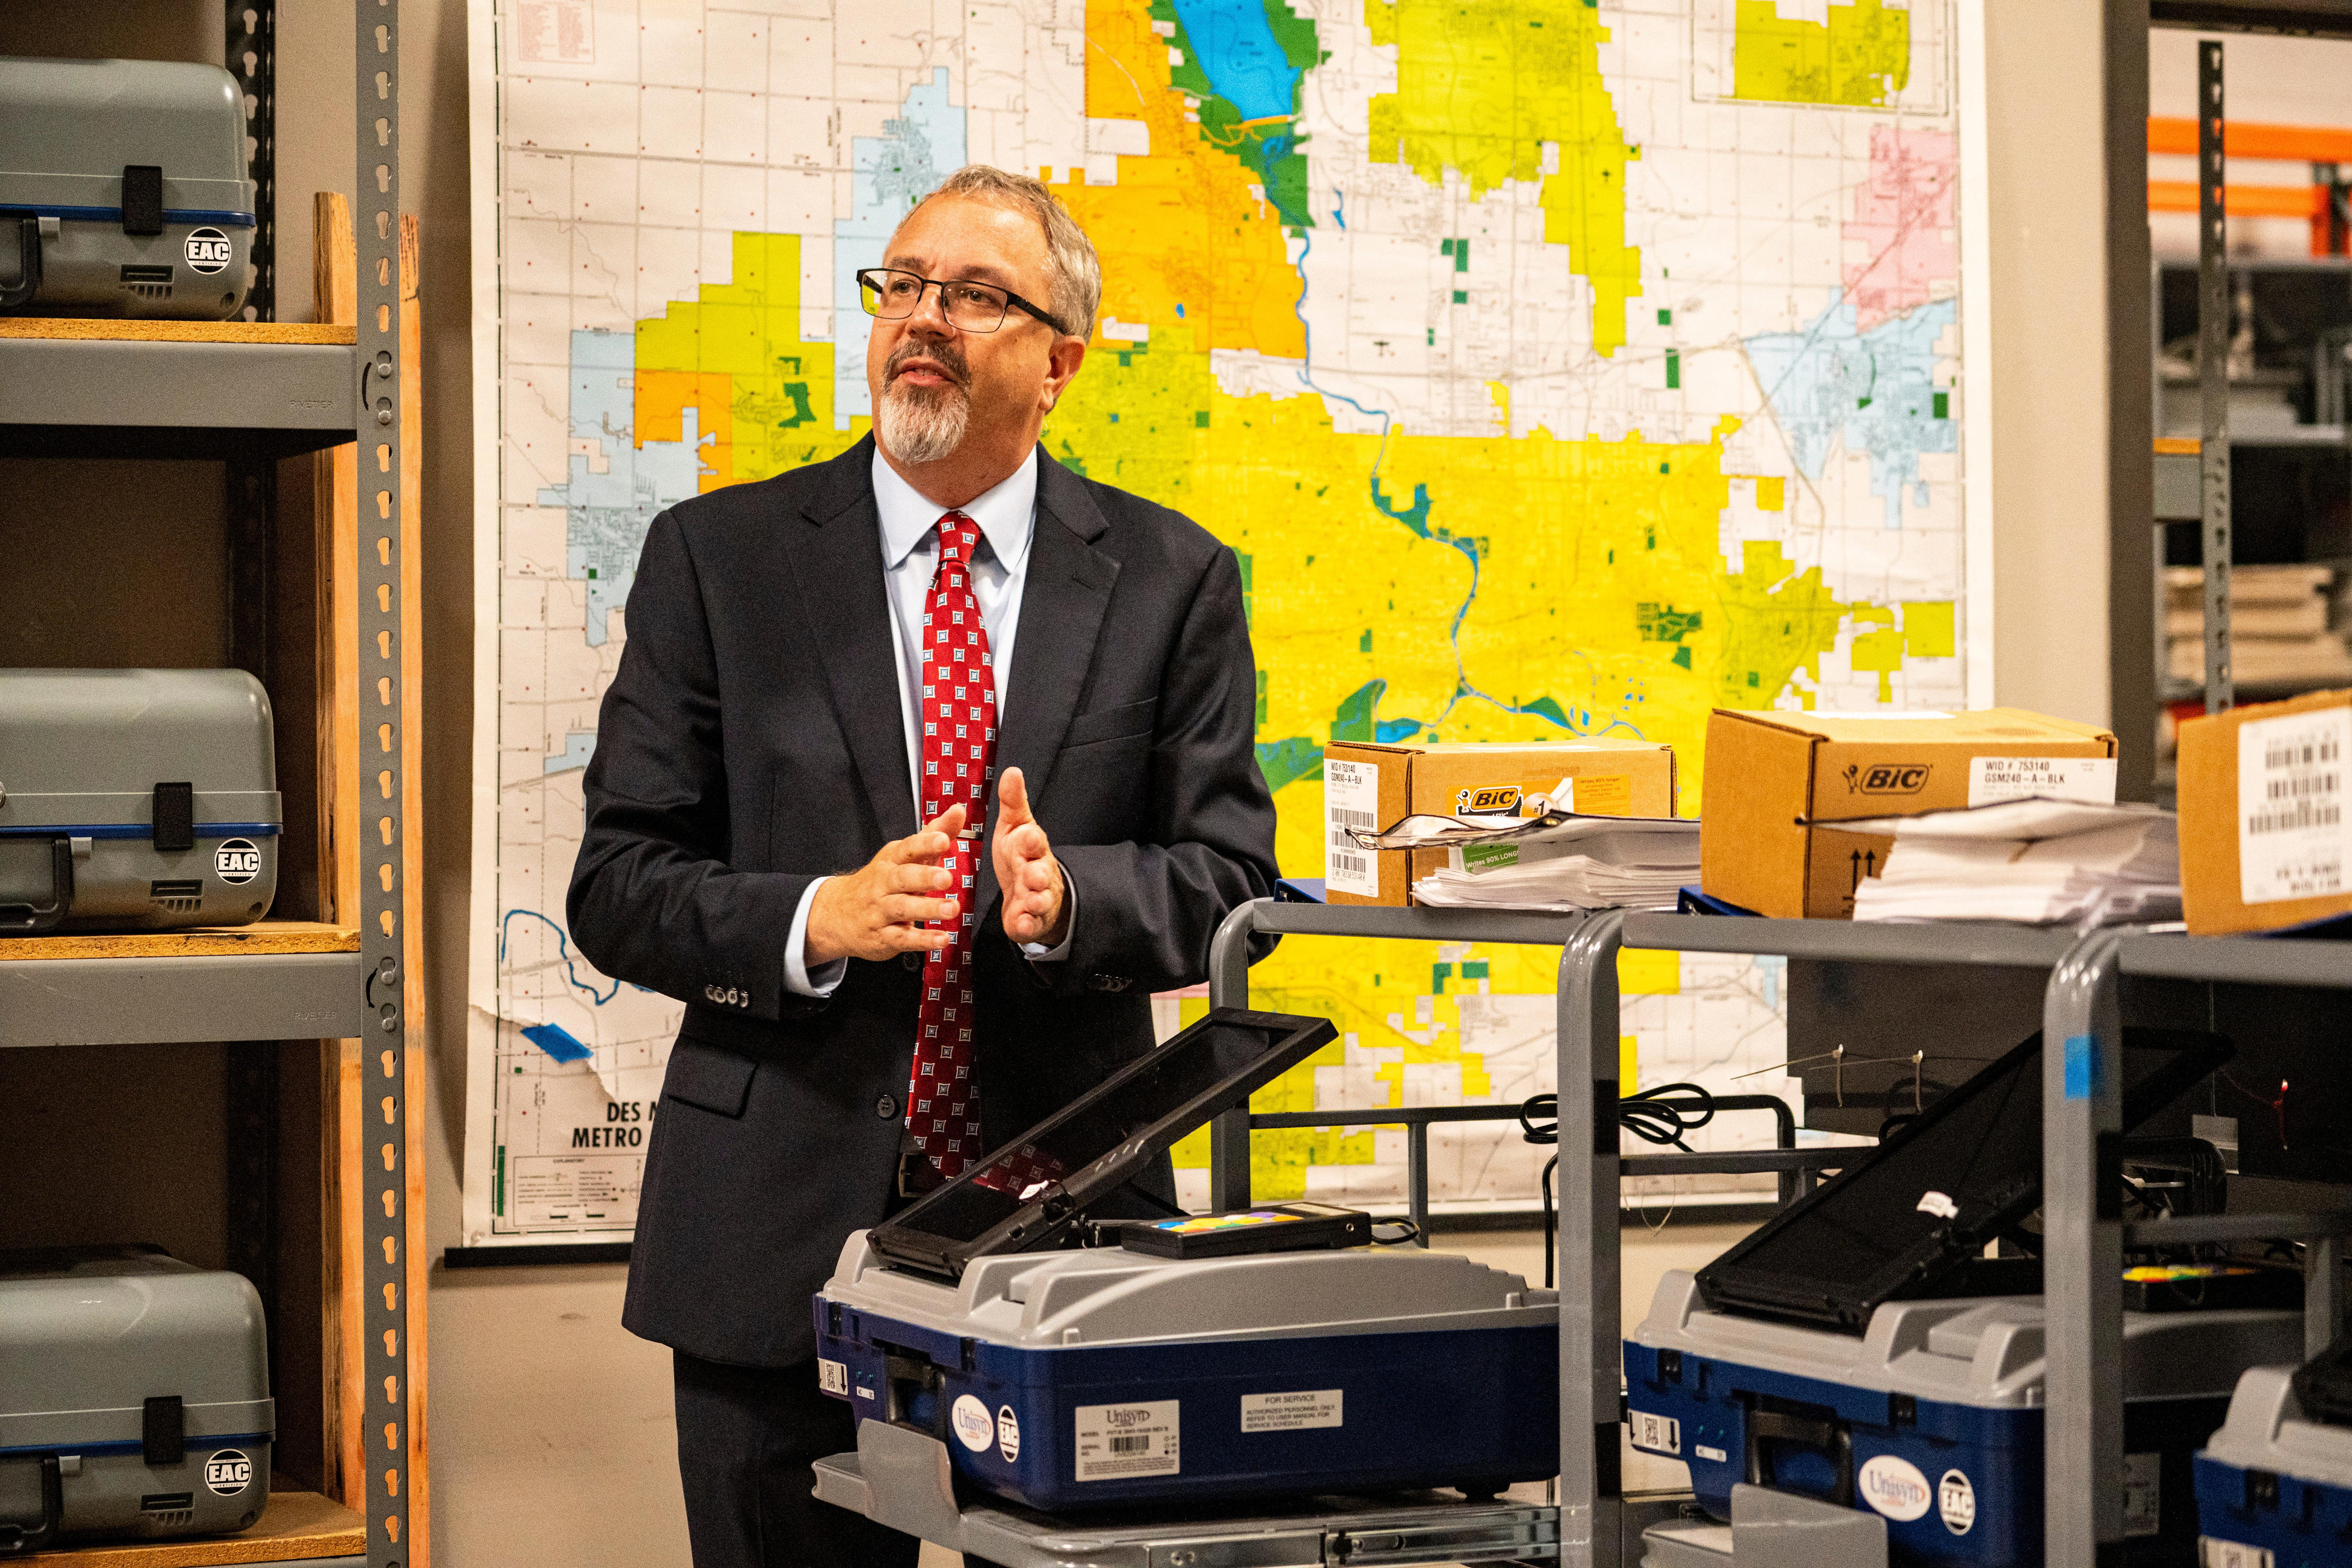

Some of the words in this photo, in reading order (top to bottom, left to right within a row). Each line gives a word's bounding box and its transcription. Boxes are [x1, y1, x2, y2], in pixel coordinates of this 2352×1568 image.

[188, 242, 229, 261] EAC
[1342, 763, 1356, 773] 753140
[1986, 761, 2004, 770] WID
[2008, 762, 2013, 770] #
[2019, 762, 2049, 771] 753140
[218, 853, 258, 871] EAC
[1466, 859, 1485, 868] Writes
[1486, 855, 1499, 863] 90%
[1500, 851, 1518, 860] LONG
[607, 1101, 641, 1122] DES
[572, 1127, 642, 1148] METRO
[958, 1407, 987, 1434] Unisyn
[1107, 1409, 1150, 1424] Unisyn
[1000, 1422, 1018, 1446] EAC
[209, 1463, 249, 1482] EAC
[1942, 1488, 1973, 1515] EAC
